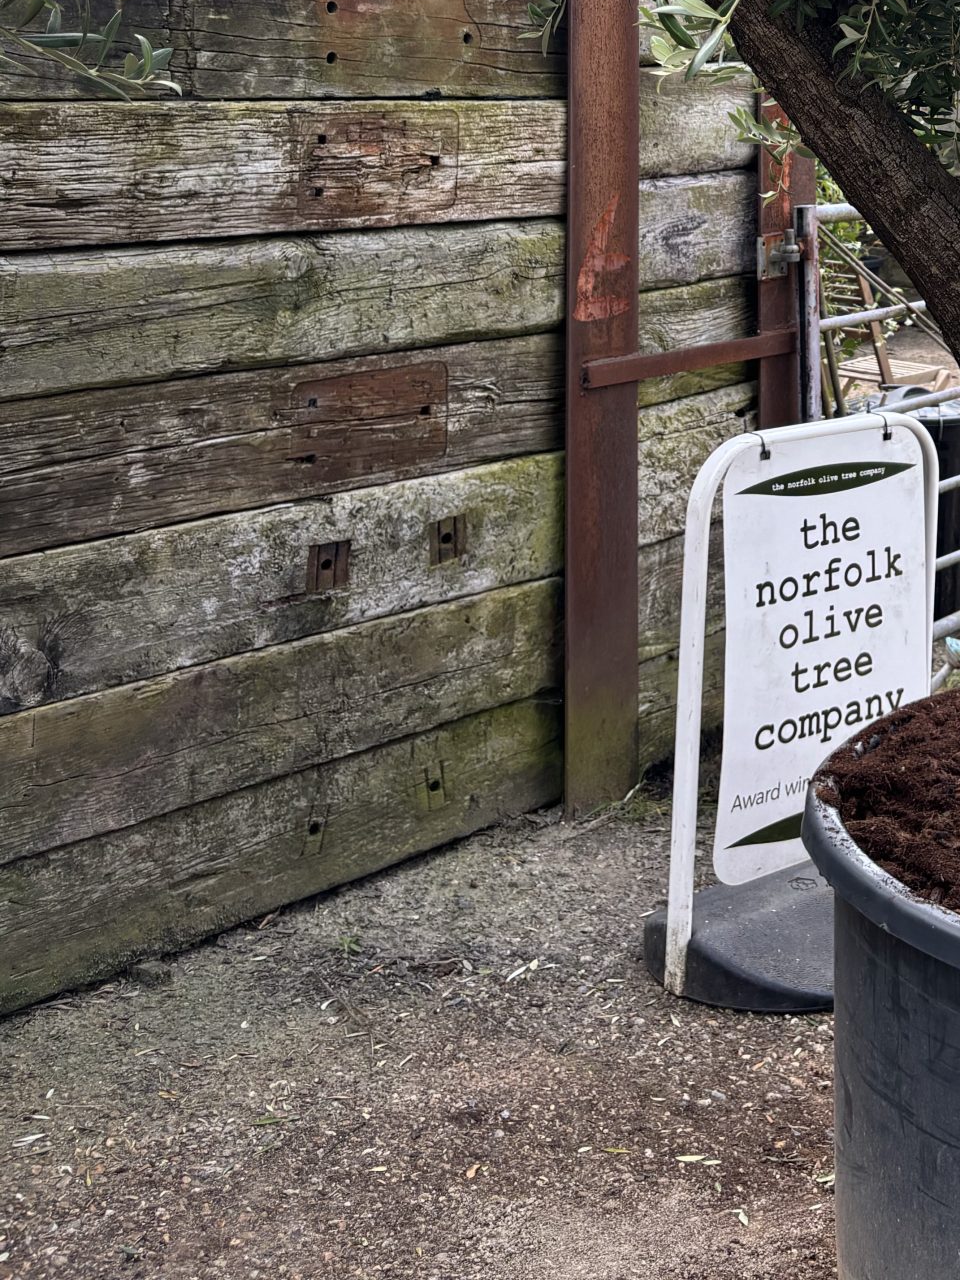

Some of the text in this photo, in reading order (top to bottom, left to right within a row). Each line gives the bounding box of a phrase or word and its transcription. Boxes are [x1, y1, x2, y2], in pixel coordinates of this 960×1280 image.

[771, 466, 886, 492] the norfolk olive tree company
[800, 513, 860, 550] the
[756, 546, 903, 608] norfolk
[779, 603, 883, 649] olive
[791, 651, 873, 693] tree
[754, 687, 904, 751] company
[731, 780, 781, 813] Award
